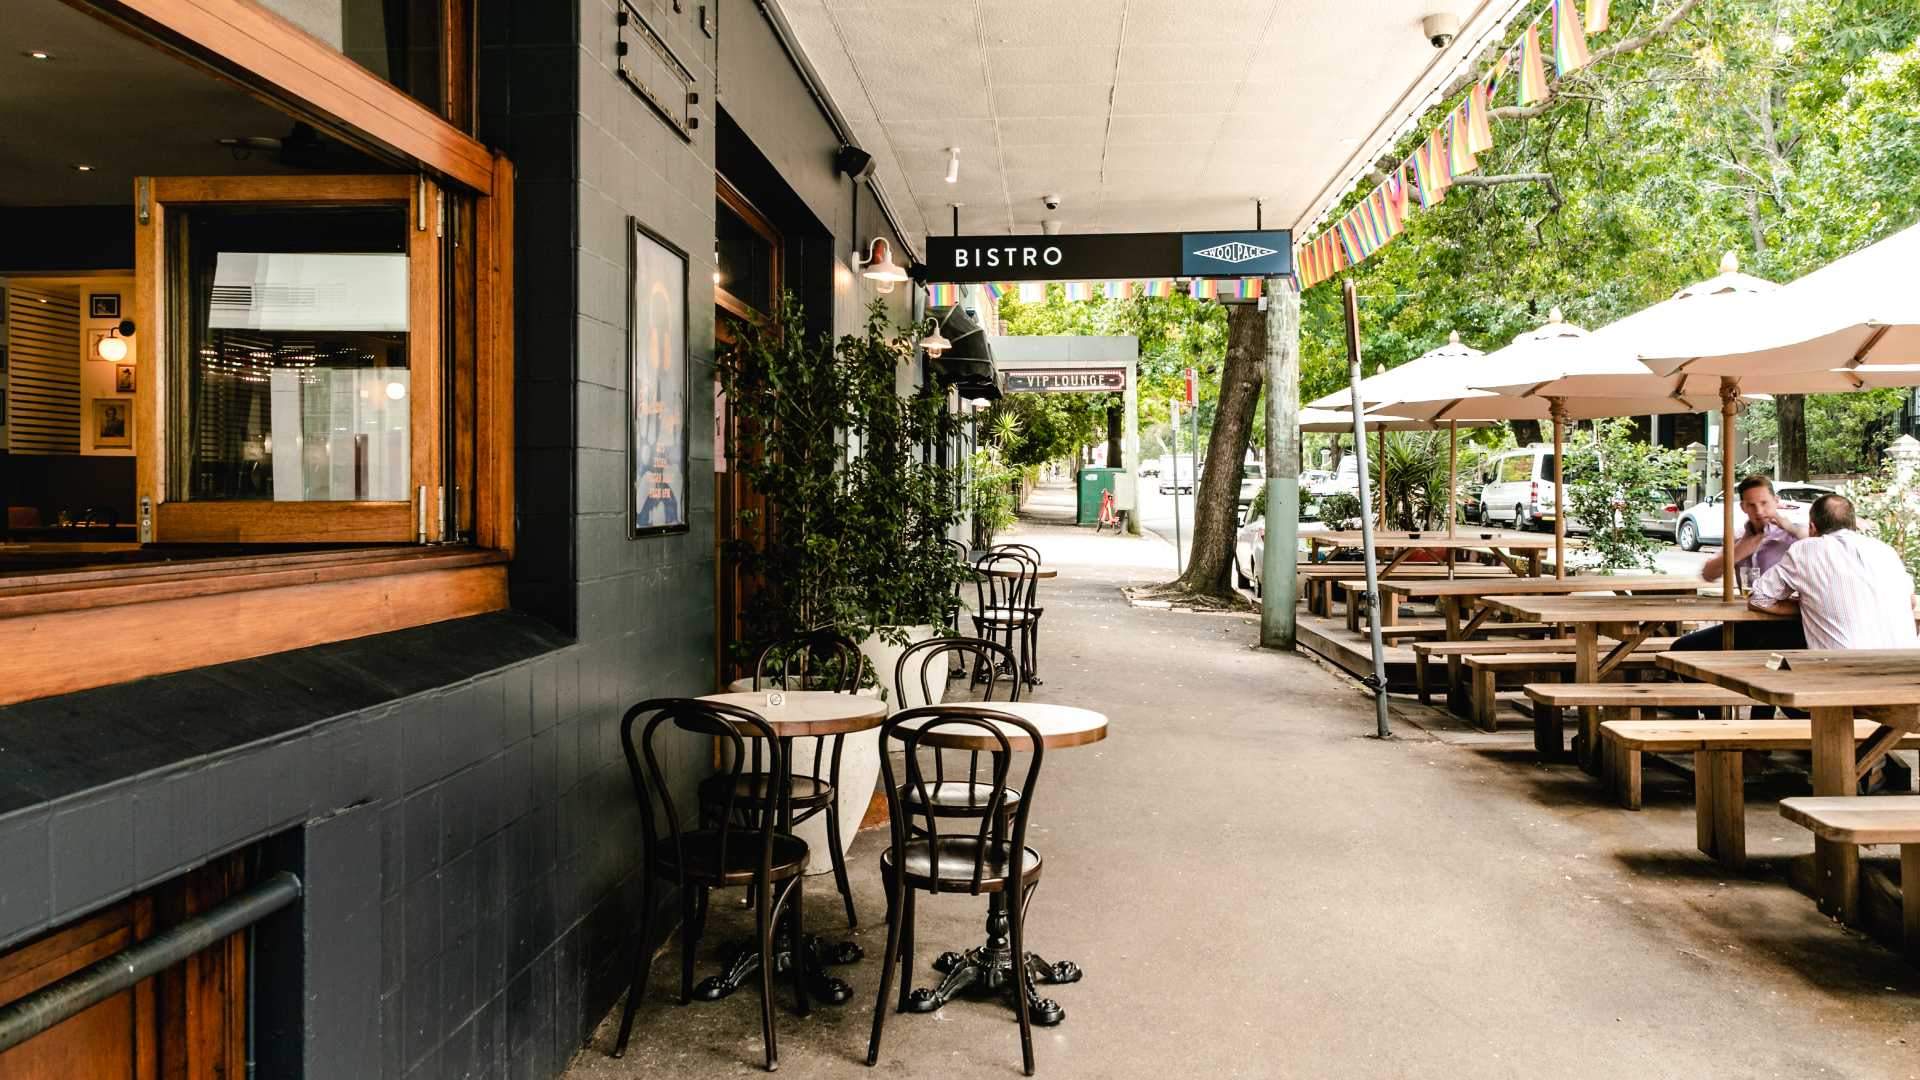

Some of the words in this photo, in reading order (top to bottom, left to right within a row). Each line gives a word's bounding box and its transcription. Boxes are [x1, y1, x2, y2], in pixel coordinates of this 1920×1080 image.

[955, 246, 1062, 267] BISTRO
[1208, 244, 1261, 261] WOOLPACK
[1026, 375, 1049, 387] VIP
[1054, 375, 1105, 387] LOUNGE
